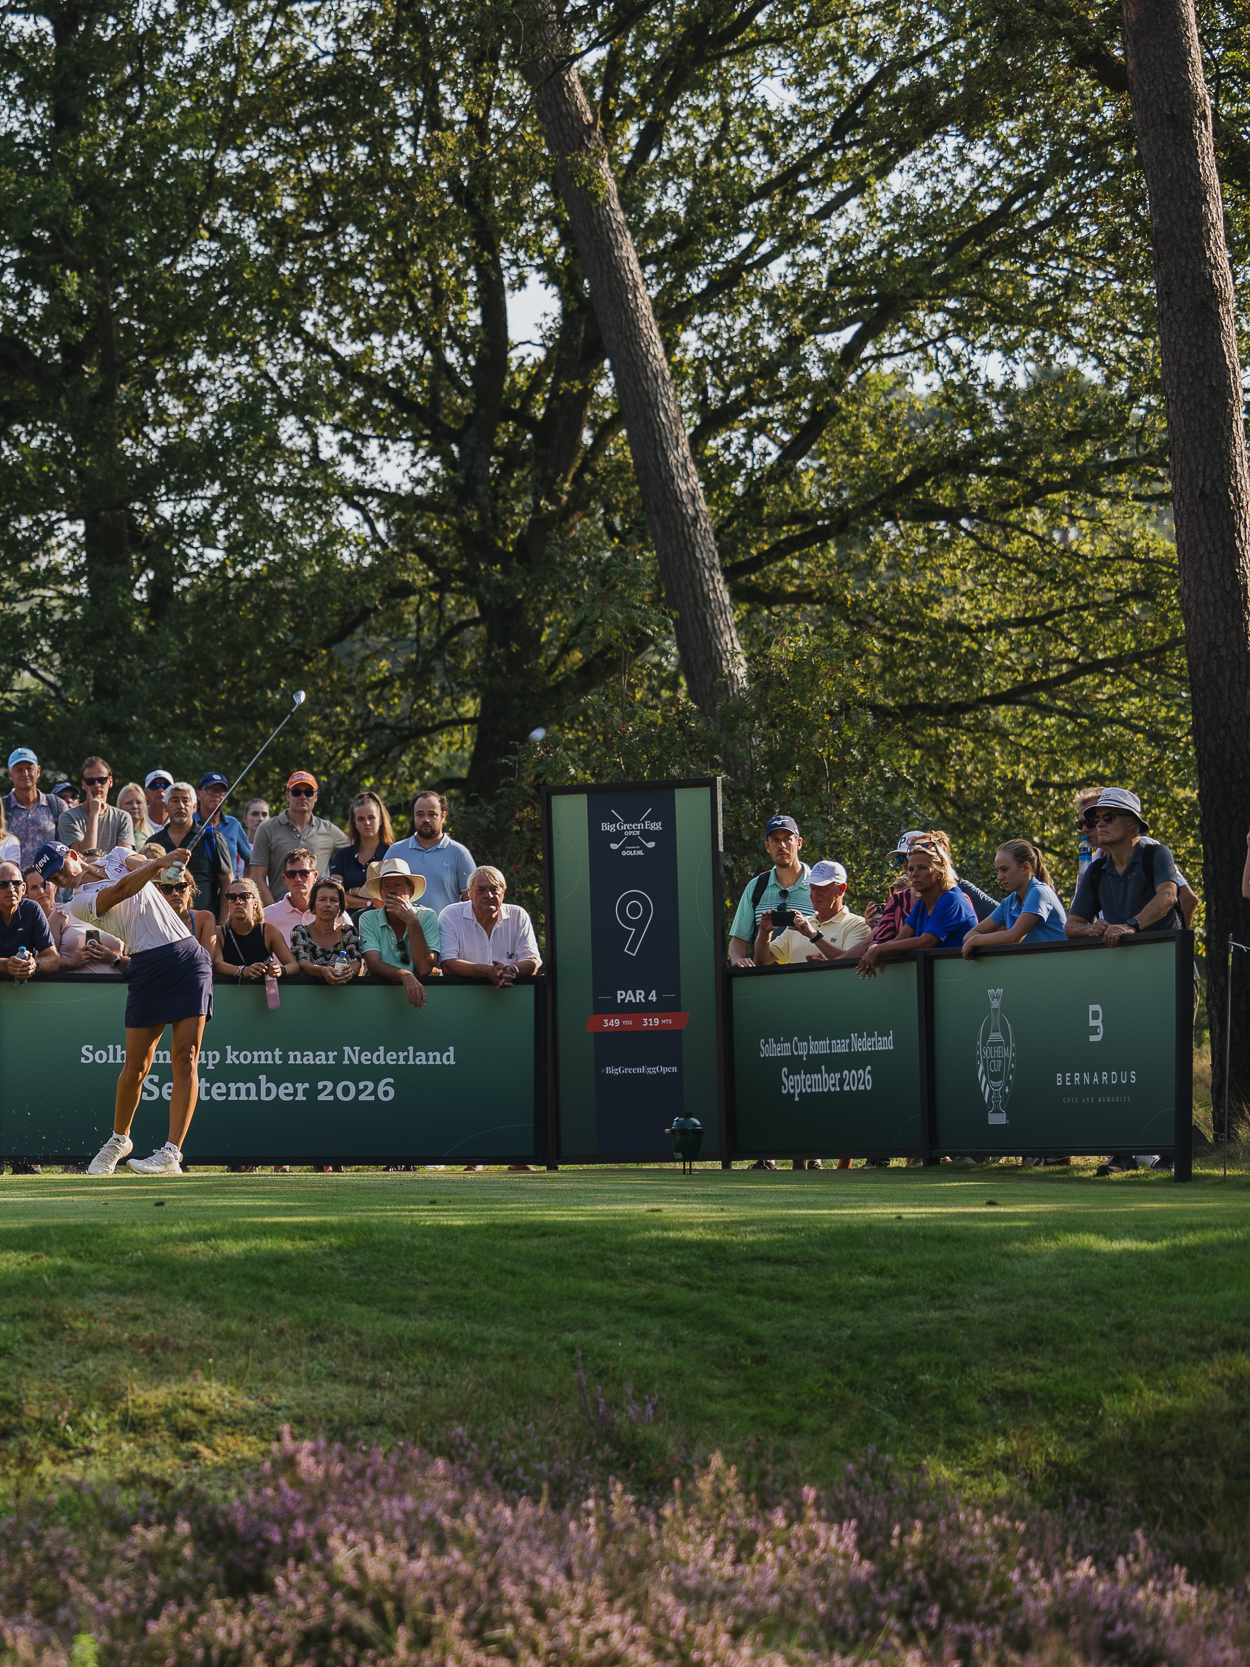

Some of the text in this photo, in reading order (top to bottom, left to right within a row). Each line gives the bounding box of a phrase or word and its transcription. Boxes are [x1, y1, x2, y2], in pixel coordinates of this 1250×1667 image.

[601, 820, 662, 833] Big Green Egg
[615, 889, 654, 957] 9
[616, 989, 658, 1003] PAR 4
[602, 1018, 620, 1028] 349
[642, 1017, 660, 1027] 319
[759, 1029, 894, 1061] Solheim Cup komt naar Nederland
[982, 1045, 1010, 1059] SOLHEIM
[80, 1044, 172, 1065] Solhm
[225, 1045, 283, 1065] komt
[287, 1050, 338, 1065] naar
[342, 1045, 456, 1066] Nederland
[601, 1064, 678, 1076] #BigGreenEggOpen
[989, 1059, 1003, 1073] CUP
[781, 1064, 873, 1101] September 2026
[1056, 1070, 1137, 1086] BERNARDUS
[141, 1074, 396, 1102] Setember 2026
